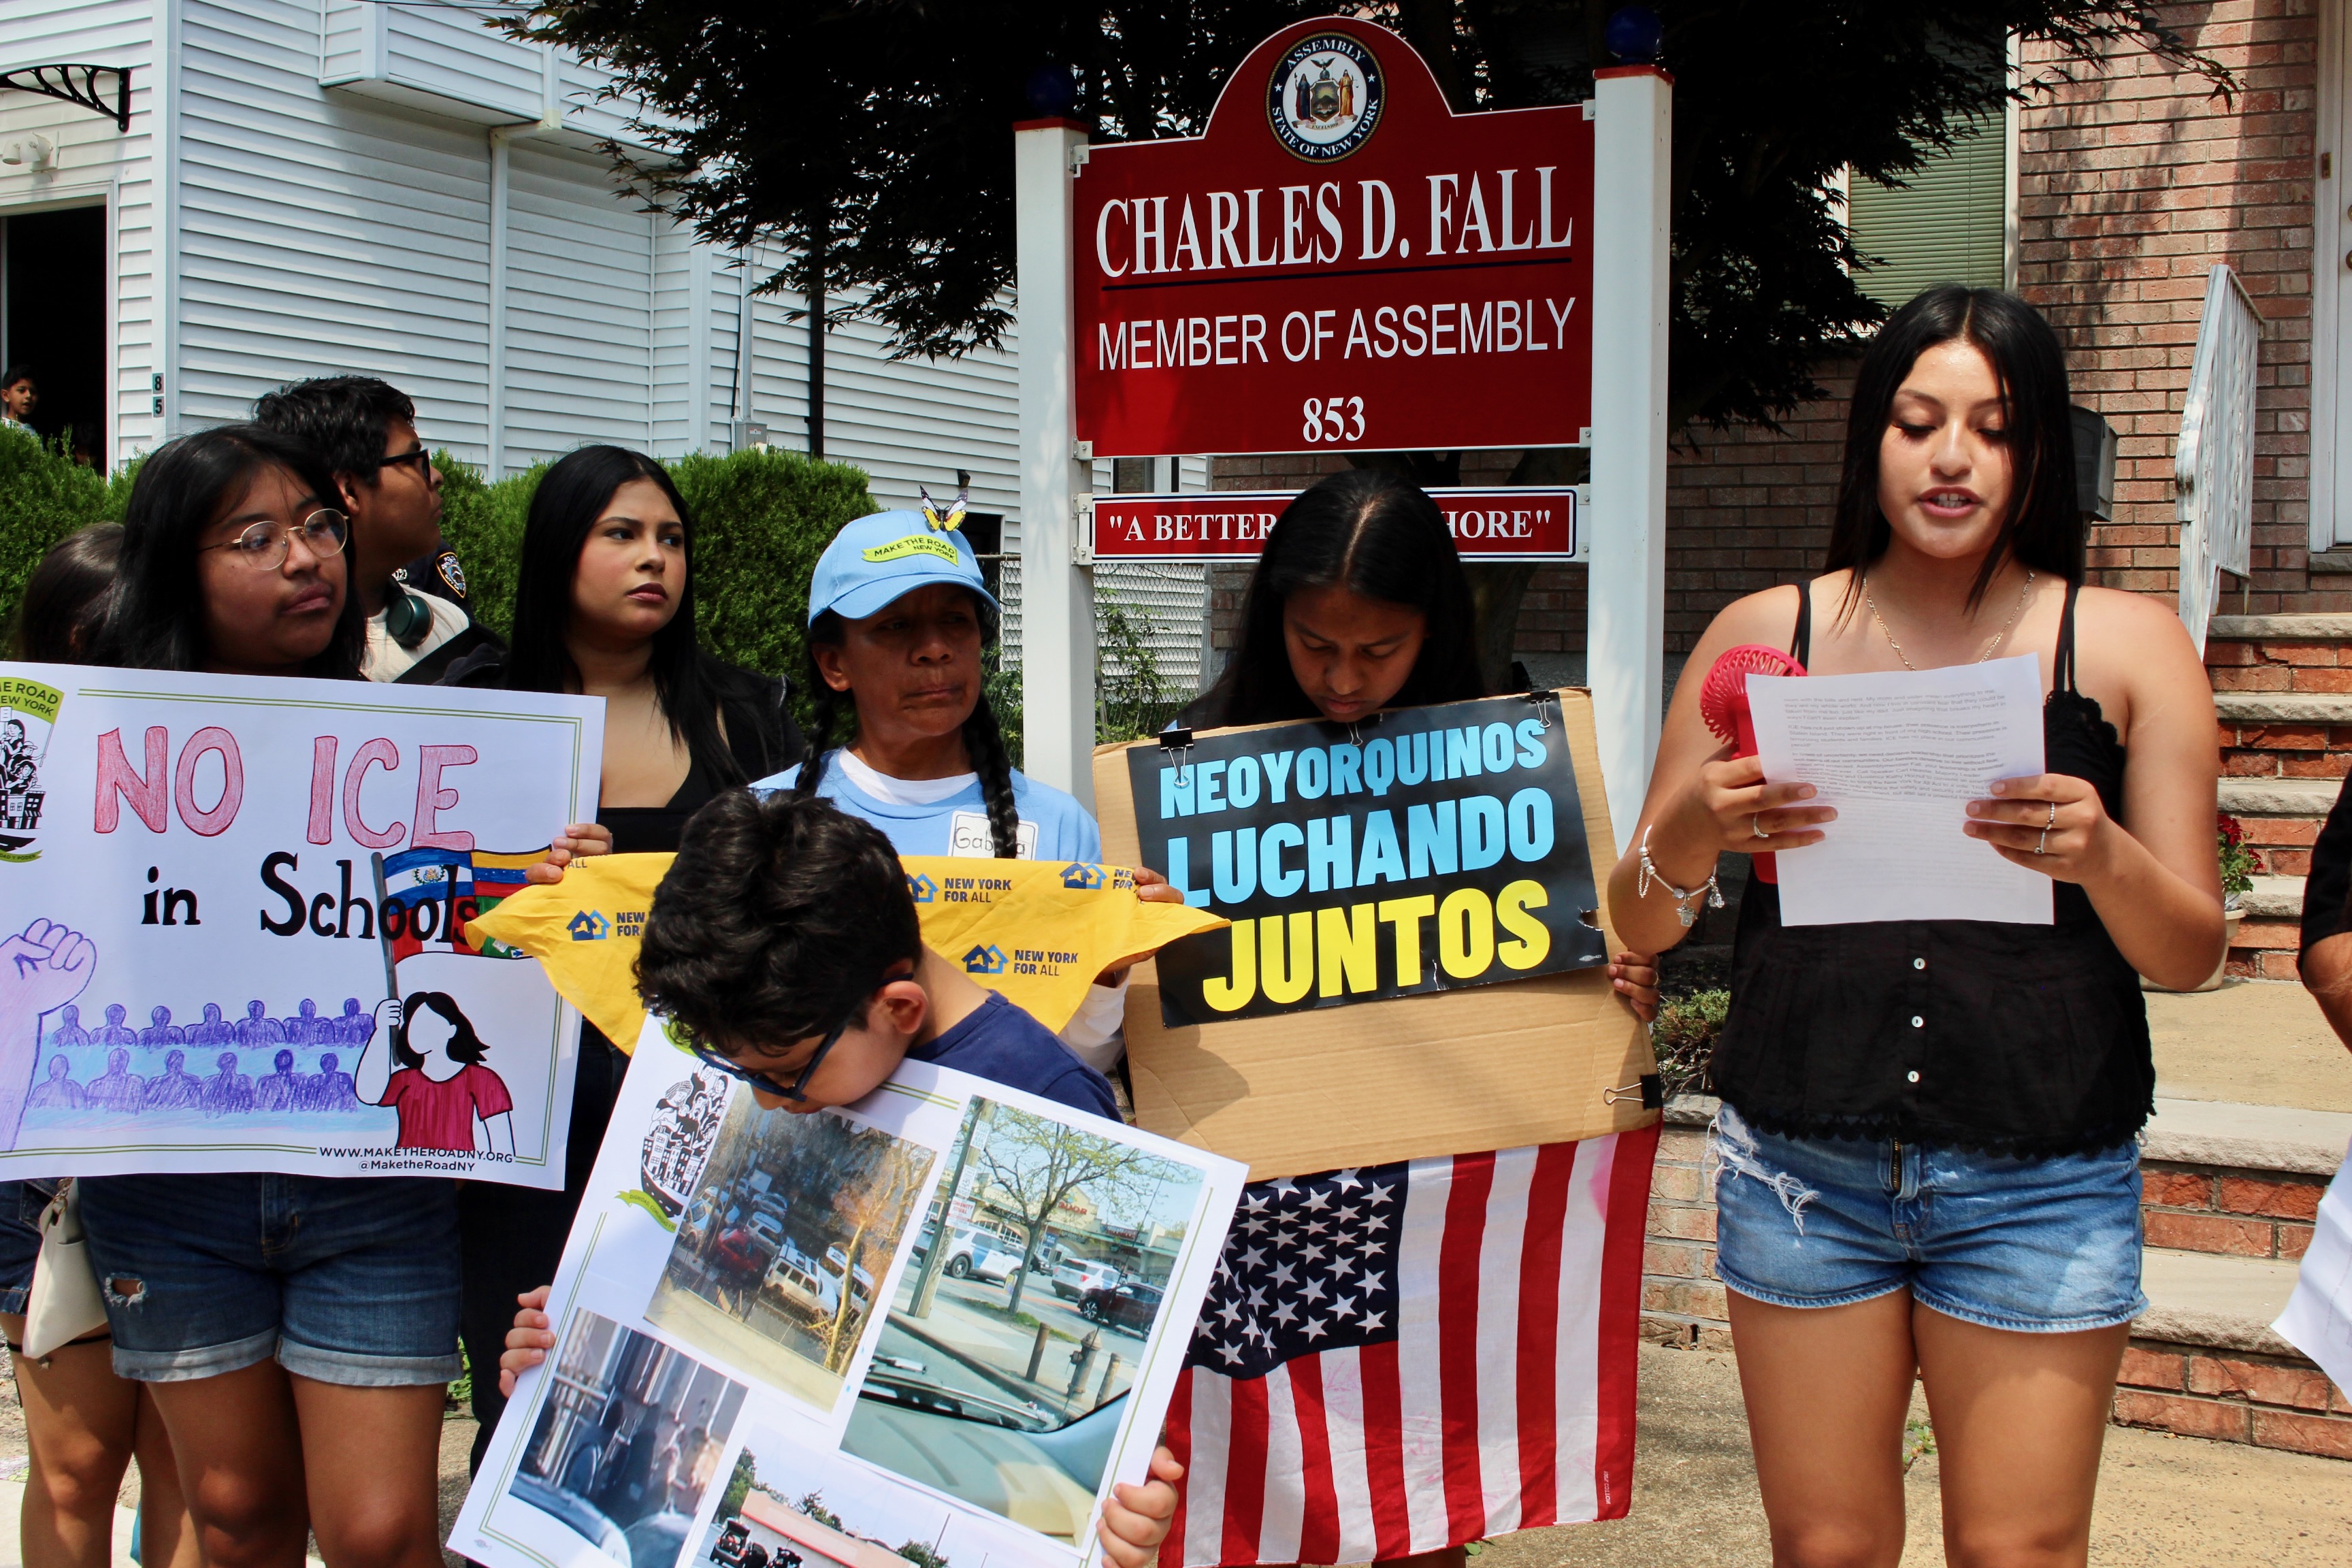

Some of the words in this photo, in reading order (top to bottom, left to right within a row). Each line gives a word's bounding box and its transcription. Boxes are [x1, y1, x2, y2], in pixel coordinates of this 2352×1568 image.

[1287, 39, 1366, 69] ASSEMBLY
[1272, 106, 1299, 148] STATE
[1299, 144, 1319, 156] OF
[1322, 137, 1353, 157] NEW
[1353, 99, 1379, 140] YORK
[1096, 181, 1343, 277] CHARLES
[1358, 180, 1409, 260] D.
[1426, 166, 1572, 256] FALL
[1098, 314, 1269, 371] MEMBER
[1281, 310, 1337, 363] OF
[1344, 297, 1576, 360] ASSEMBLY
[1303, 396, 1366, 443] 853
[1109, 515, 1146, 541] "A
[1153, 513, 1277, 540] BETTER
[874, 542, 903, 557] MAKE
[904, 538, 925, 546] THE
[927, 539, 955, 554] ROAD
[934, 546, 955, 559] YORK
[16, 683, 59, 704] ROAD
[0, 696, 20, 704] EW
[24, 698, 54, 717] YORK
[1160, 718, 1548, 819] NEOYORQUINOS
[94, 726, 244, 837] NO
[306, 736, 478, 851] ICE
[1167, 787, 1554, 909] LUCHANDO
[945, 877, 974, 889] NEW
[978, 878, 1012, 891] YORK
[1113, 879, 1133, 890] FOR
[141, 866, 201, 926] in
[261, 851, 480, 945] Schools
[944, 891, 968, 902] FOR
[970, 892, 992, 903] ALL
[617, 912, 645, 924] NEW
[617, 925, 640, 936] FOR
[1203, 879, 1550, 1012] JUNTOS
[1015, 949, 1045, 962] NEW
[1047, 951, 1078, 964] YORK
[1013, 963, 1037, 975] FOR
[1040, 964, 1060, 976] ALL
[319, 1147, 512, 1163] WWW.MAKETHEROADNY.ORG
[359, 1160, 475, 1172] @MaketheRoadNY
